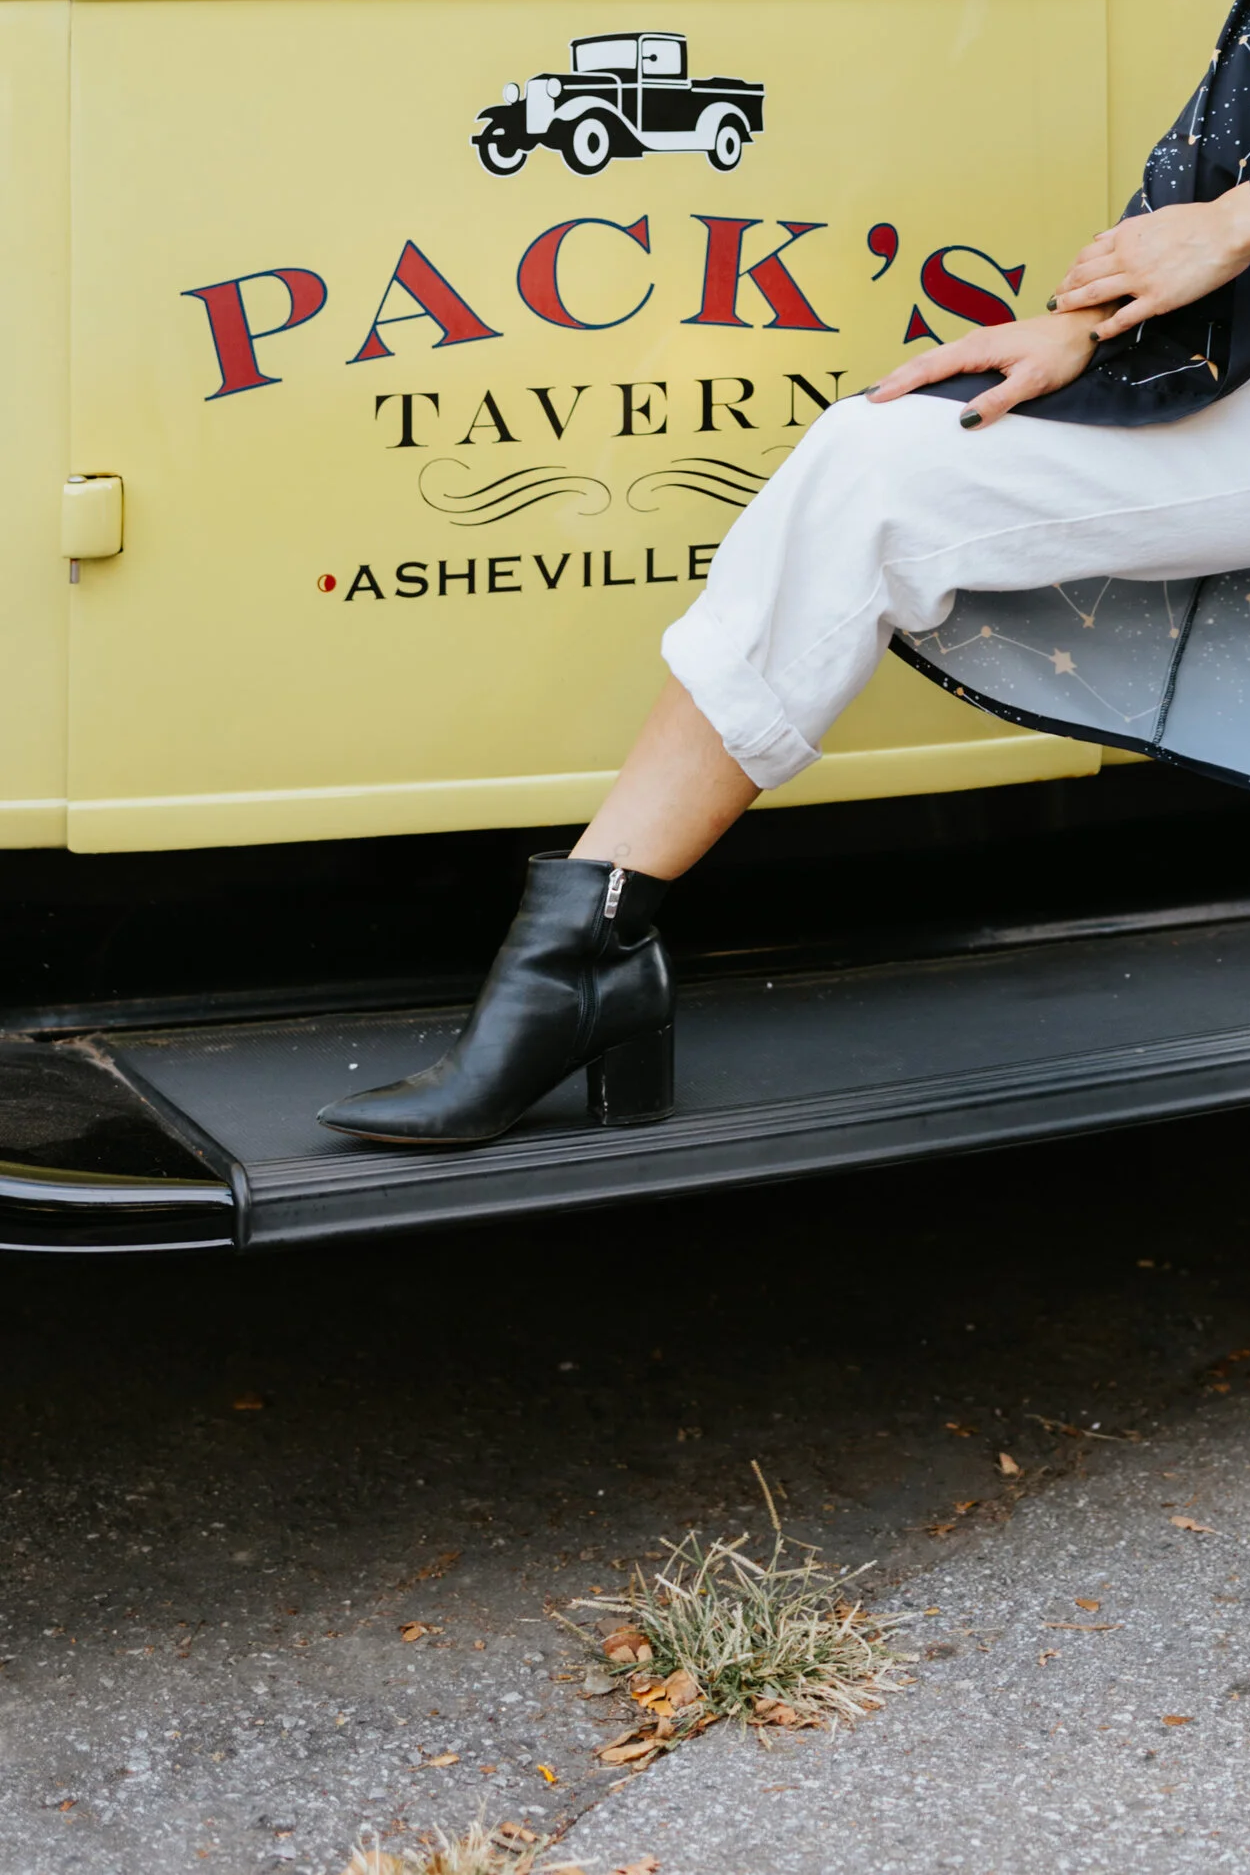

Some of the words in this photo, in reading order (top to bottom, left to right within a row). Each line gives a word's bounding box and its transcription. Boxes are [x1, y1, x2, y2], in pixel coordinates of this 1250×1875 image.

[180, 213, 1026, 401] PACK'S
[375, 370, 849, 449] TAVERN
[343, 543, 721, 602] ASHEVILLE
